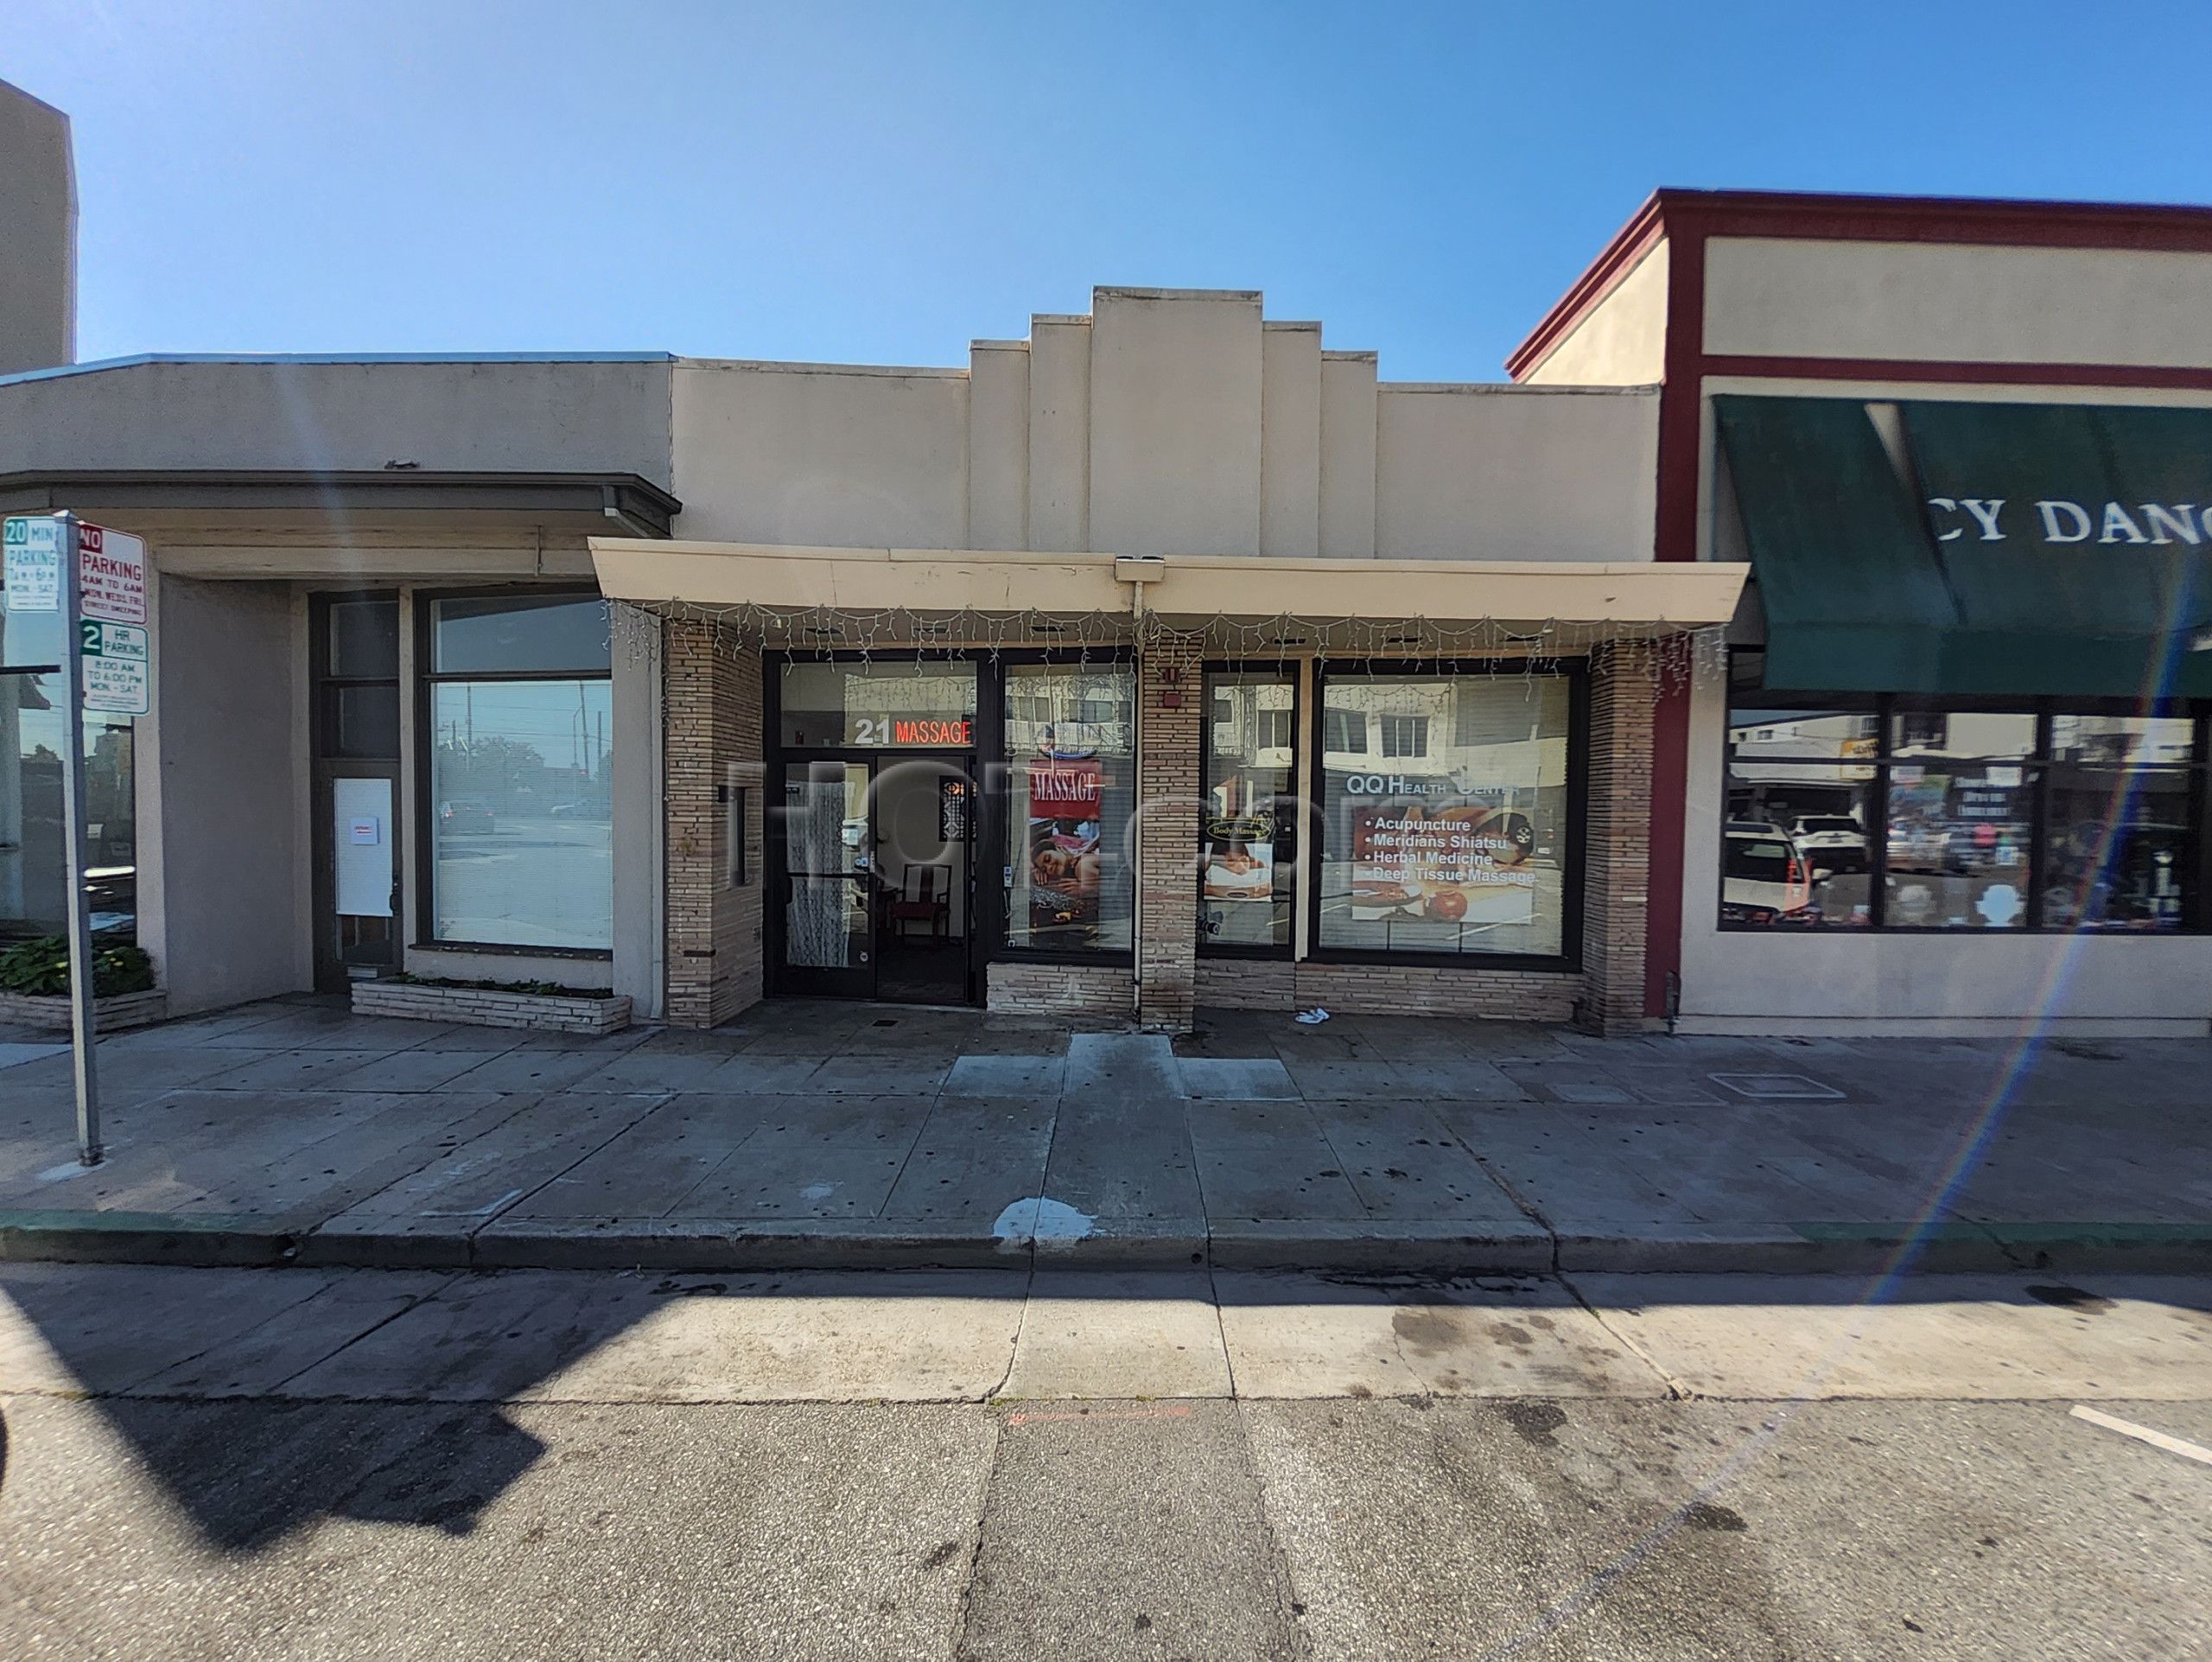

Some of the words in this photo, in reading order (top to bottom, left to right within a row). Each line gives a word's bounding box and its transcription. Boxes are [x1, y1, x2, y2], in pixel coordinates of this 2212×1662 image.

[2035, 500, 2212, 545] DAN
[5, 522, 25, 542] 20
[31, 527, 52, 540] MIN
[80, 528, 100, 548] NO
[9, 550, 55, 565] PARKING
[83, 554, 141, 581] PARKING
[82, 575, 102, 585] 4AM
[108, 579, 118, 589] TO
[124, 583, 143, 593] 6AM
[83, 625, 100, 649] 2
[115, 629, 130, 640] HR
[105, 640, 143, 655] PARKING
[122, 664, 135, 672] AM
[87, 670, 100, 679] TO
[129, 674, 142, 684] PM
[91, 681, 109, 691] MON
[855, 718, 889, 744] 21
[895, 720, 971, 744] MASSAGE
[1034, 772, 1096, 802] MASSAGE
[1346, 775, 1383, 794] QQ
[1388, 775, 1446, 794] HEALTH
[1213, 826, 1232, 836] Body
[1375, 817, 1471, 831] Acupuncture
[1373, 834, 1446, 848] Meridians
[1451, 835, 1508, 850] Shiatsu
[1374, 852, 1421, 863] Herbal
[1426, 854, 1493, 865] Medicine
[1373, 867, 1409, 881] Deep
[1414, 869, 1464, 881] Tissue
[1468, 869, 1536, 883] Massage
